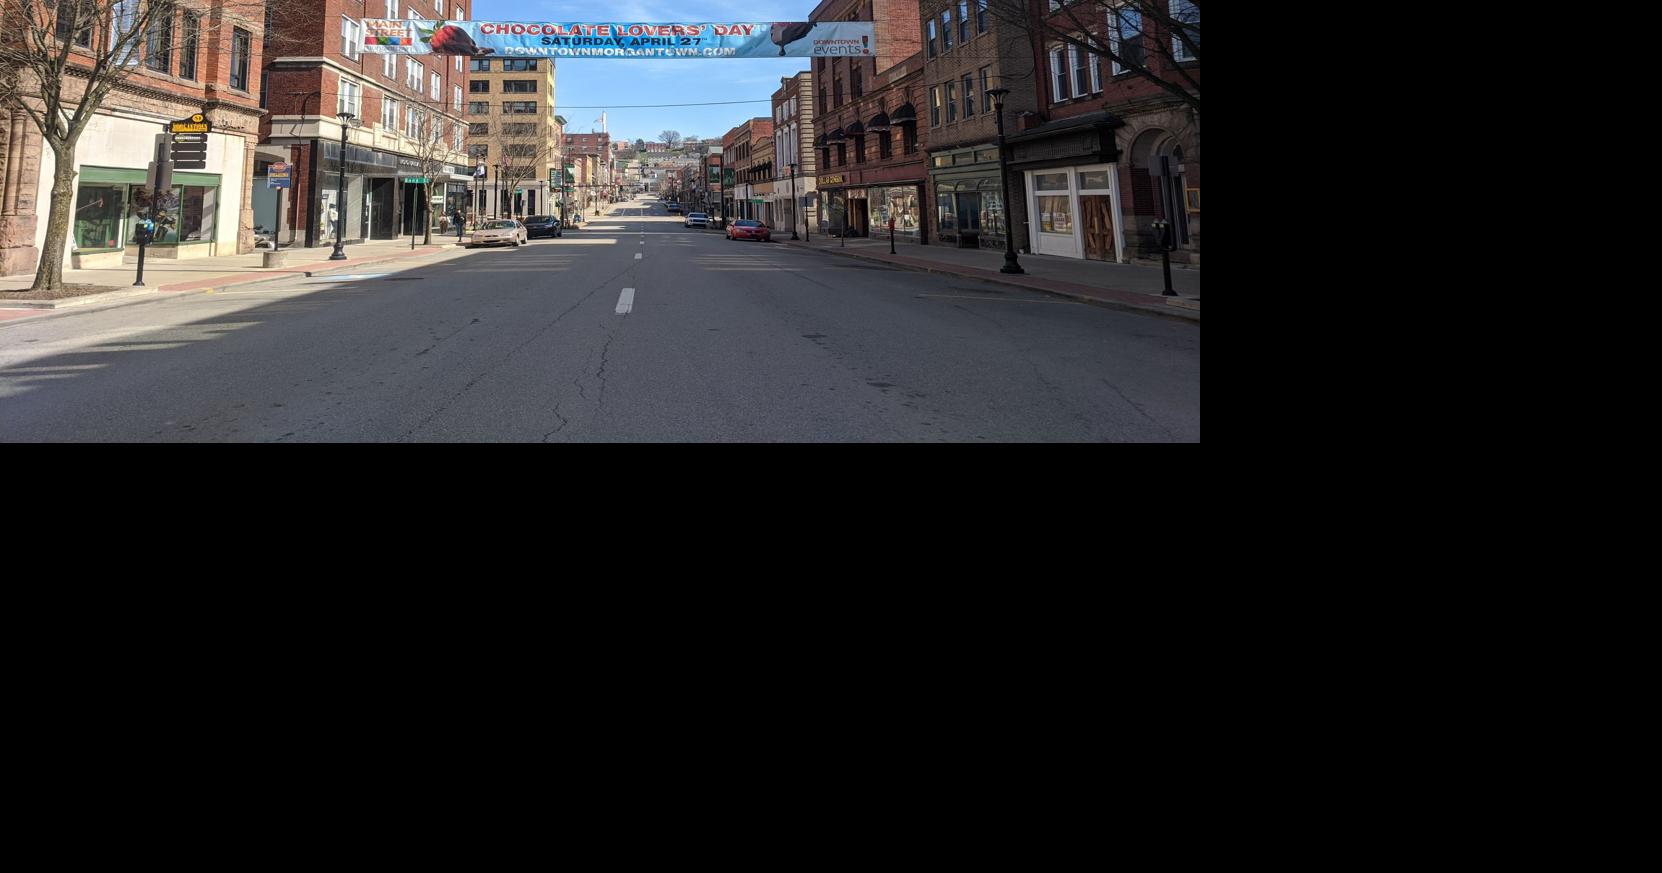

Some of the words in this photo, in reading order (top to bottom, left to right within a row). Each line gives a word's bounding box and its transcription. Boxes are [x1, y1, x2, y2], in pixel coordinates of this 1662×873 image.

[365, 29, 413, 37] STREET
[480, 23, 610, 36] CHOCOLATE
[616, 24, 706, 36] LOVERS'
[714, 24, 754, 36] DAY
[541, 37, 625, 48] SATURDAY,
[630, 37, 675, 46] APRIL
[504, 46, 736, 56] DOWNTOWNMORGANTOWN.COM
